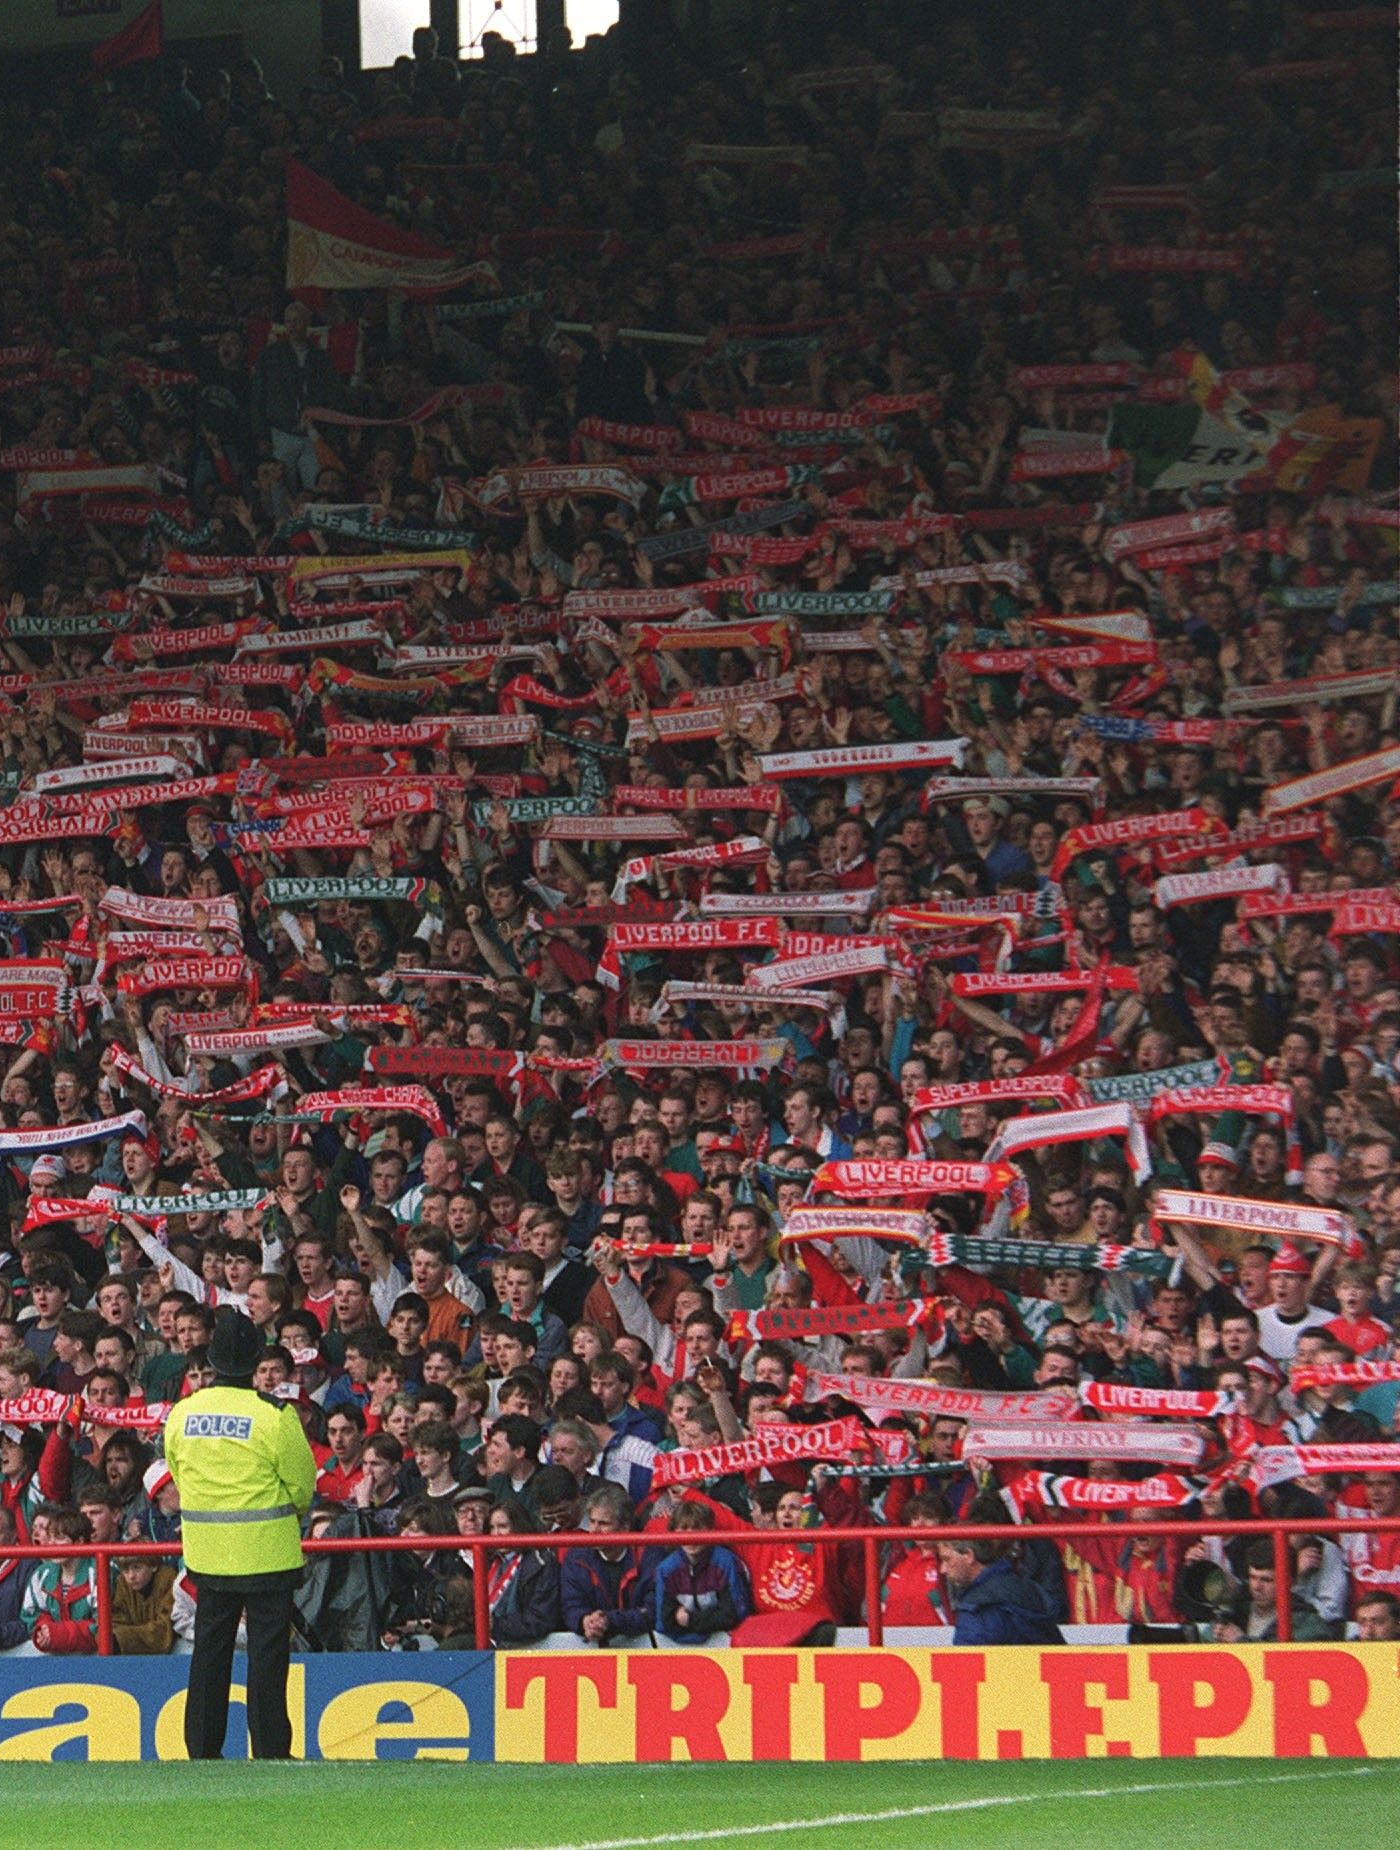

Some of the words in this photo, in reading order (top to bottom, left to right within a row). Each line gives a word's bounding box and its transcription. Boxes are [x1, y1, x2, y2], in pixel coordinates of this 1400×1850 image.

[89, 504, 148, 520] LIVERP
[761, 595, 886, 611] LIVERPOOL
[695, 682, 781, 702] LIVERPOOL
[149, 704, 256, 724] LIVERPOOL
[84, 733, 145, 750] LIVERPOOL
[333, 725, 436, 739] LIVERPOOL
[811, 747, 893, 765] LIVERPOOL
[91, 778, 209, 811] LIVERPOOL
[1079, 815, 1194, 844] LIVERPOOL
[1158, 816, 1319, 857] LIVERPOOL
[246, 830, 369, 849] LVERPOOL
[271, 878, 406, 897] LIVERPOOL
[613, 925, 725, 944] LIVERPOOL
[191, 1035, 269, 1050] LIVERPOOL
[626, 1043, 755, 1060] LIVERPOOL
[931, 1083, 980, 1099] SUPER
[991, 1076, 1065, 1092] LIVERPOOL
[847, 1163, 978, 1182] LIVERPOOL
[116, 1191, 256, 1211] LIVERPOOL
[1189, 1199, 1299, 1226] LIVERPOOL
[849, 1380, 983, 1410] LIVERPOOL
[1099, 1388, 1202, 1407] LIVERPOOL
[187, 1415, 248, 1437] POLICE
[676, 1426, 841, 1475] LIVERPOOL
[1073, 1480, 1174, 1501] LIVERPOOL
